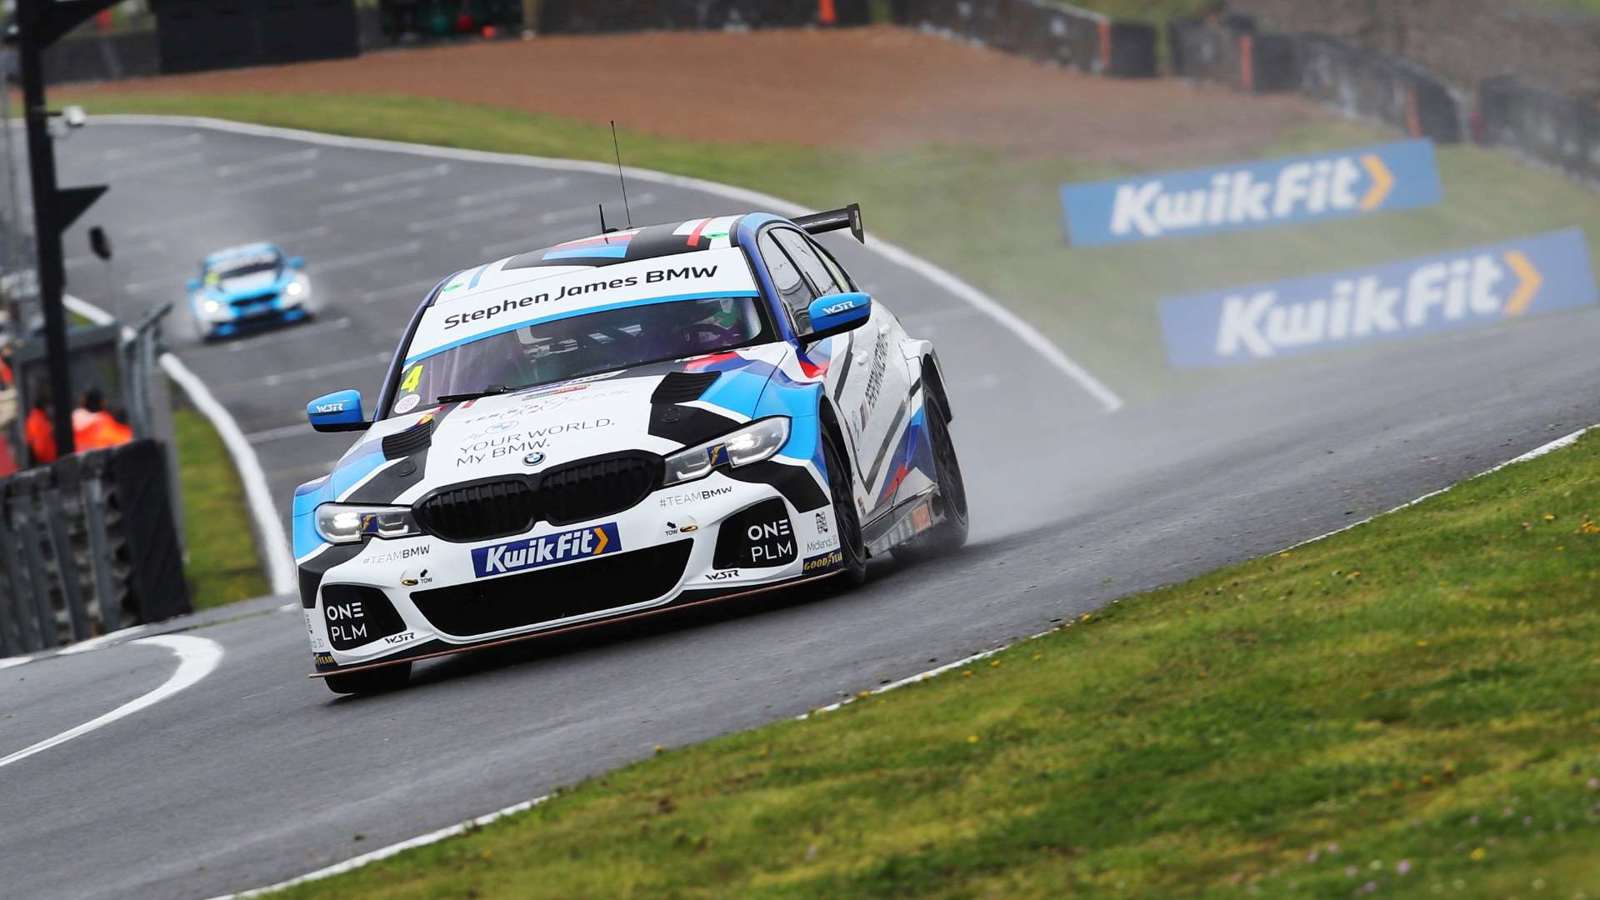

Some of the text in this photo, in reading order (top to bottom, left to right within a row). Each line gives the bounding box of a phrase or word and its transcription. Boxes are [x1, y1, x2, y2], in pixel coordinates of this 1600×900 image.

[444, 265, 718, 330] Stephen James BMW
[401, 365, 424, 392] 4
[460, 417, 616, 455] YOUR WORLD.
[491, 439, 551, 458] BMW.
[660, 485, 734, 508] #TEAMBMW
[747, 519, 791, 541] ONE
[751, 542, 793, 563] PLM
[326, 602, 364, 621] ONE
[331, 623, 368, 642] PLM
